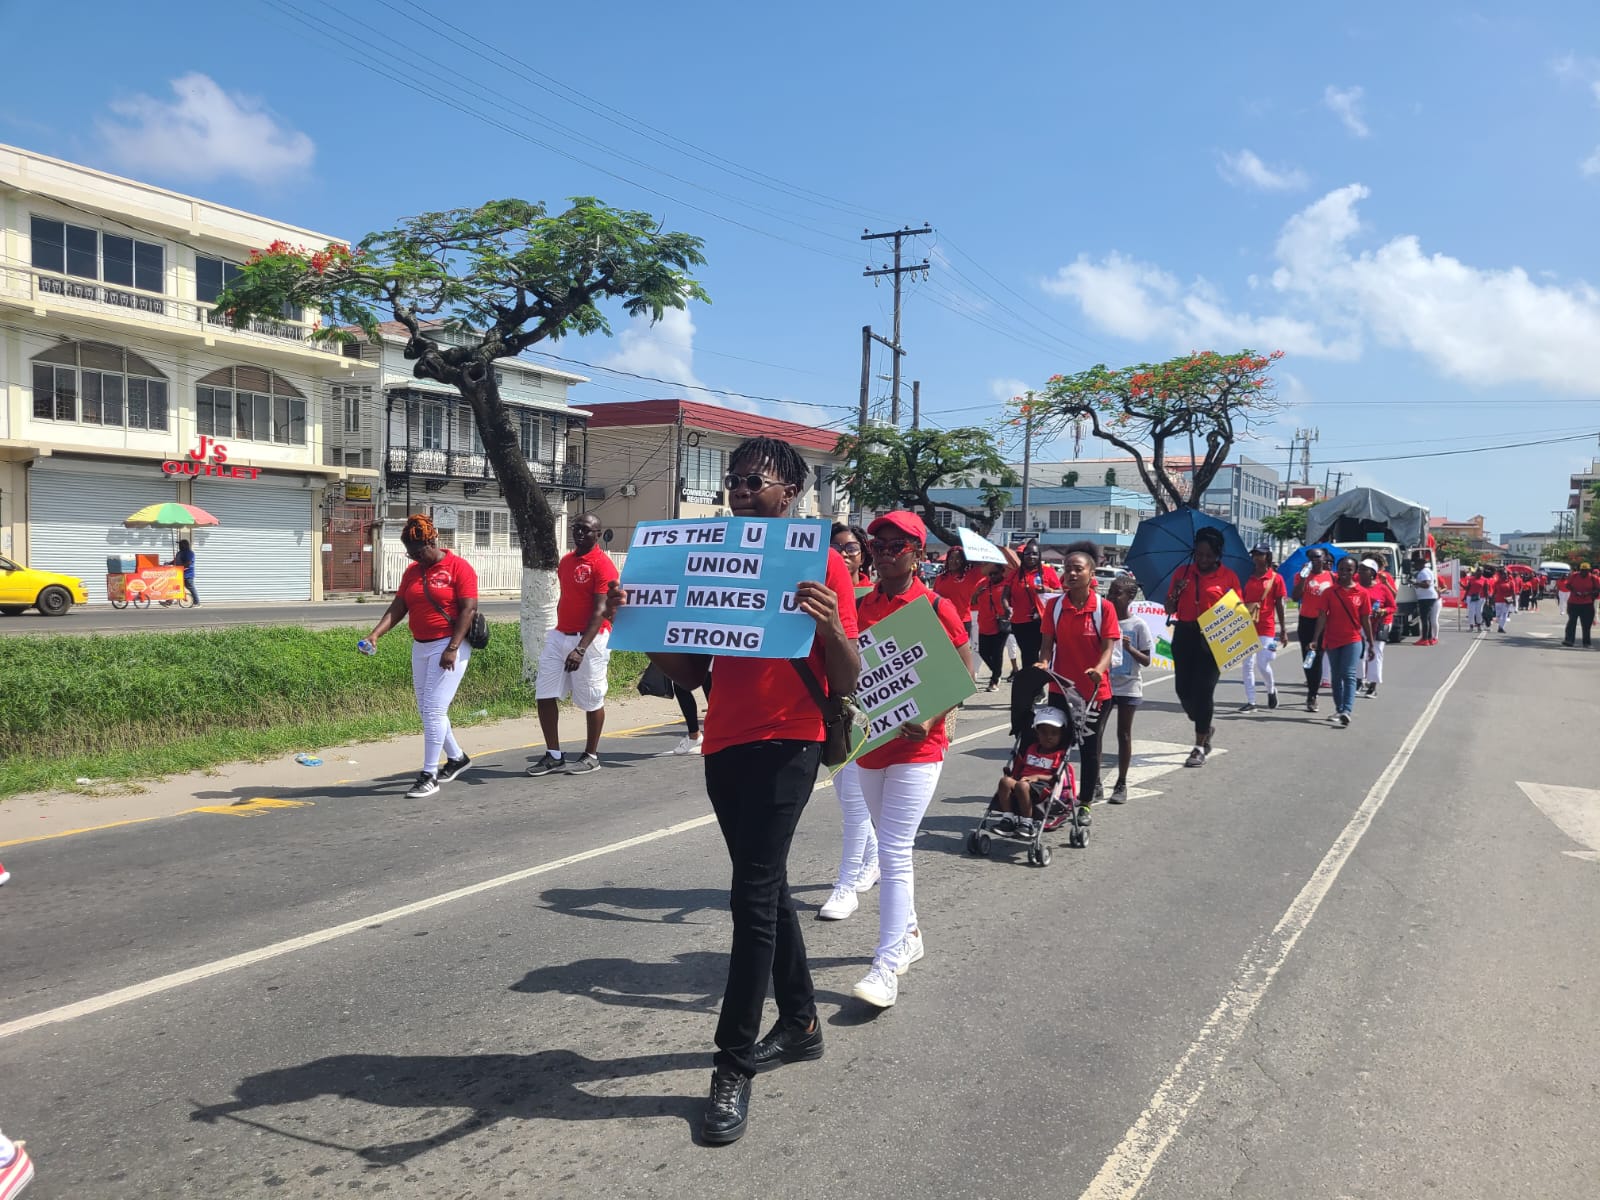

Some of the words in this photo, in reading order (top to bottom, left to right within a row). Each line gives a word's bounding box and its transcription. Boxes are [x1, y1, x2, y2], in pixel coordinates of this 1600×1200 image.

[189, 435, 228, 463] J's
[162, 461, 262, 480] OUTLET
[682, 488, 718, 498] COMMERCIAL
[687, 496, 714, 505] REGISTRY
[643, 529, 678, 545] IT'S
[685, 527, 726, 544] THE
[746, 527, 763, 543] U
[790, 531, 815, 548] IN
[687, 556, 759, 575] UNION
[625, 589, 677, 605] THAT
[686, 591, 766, 609] MAKES
[783, 595, 809, 612] U
[1214, 604, 1226, 615] WE
[1204, 610, 1234, 633] DEMAND
[1208, 626, 1227, 641] THAT
[1228, 616, 1243, 628] YOU
[667, 628, 760, 649] STRONG
[1220, 621, 1250, 644] RESPECT
[879, 641, 897, 658] IS
[1223, 644, 1259, 669] TEACHERS
[1227, 640, 1242, 653] OUR
[862, 672, 915, 709] WORK
[893, 701, 917, 722] IT!
